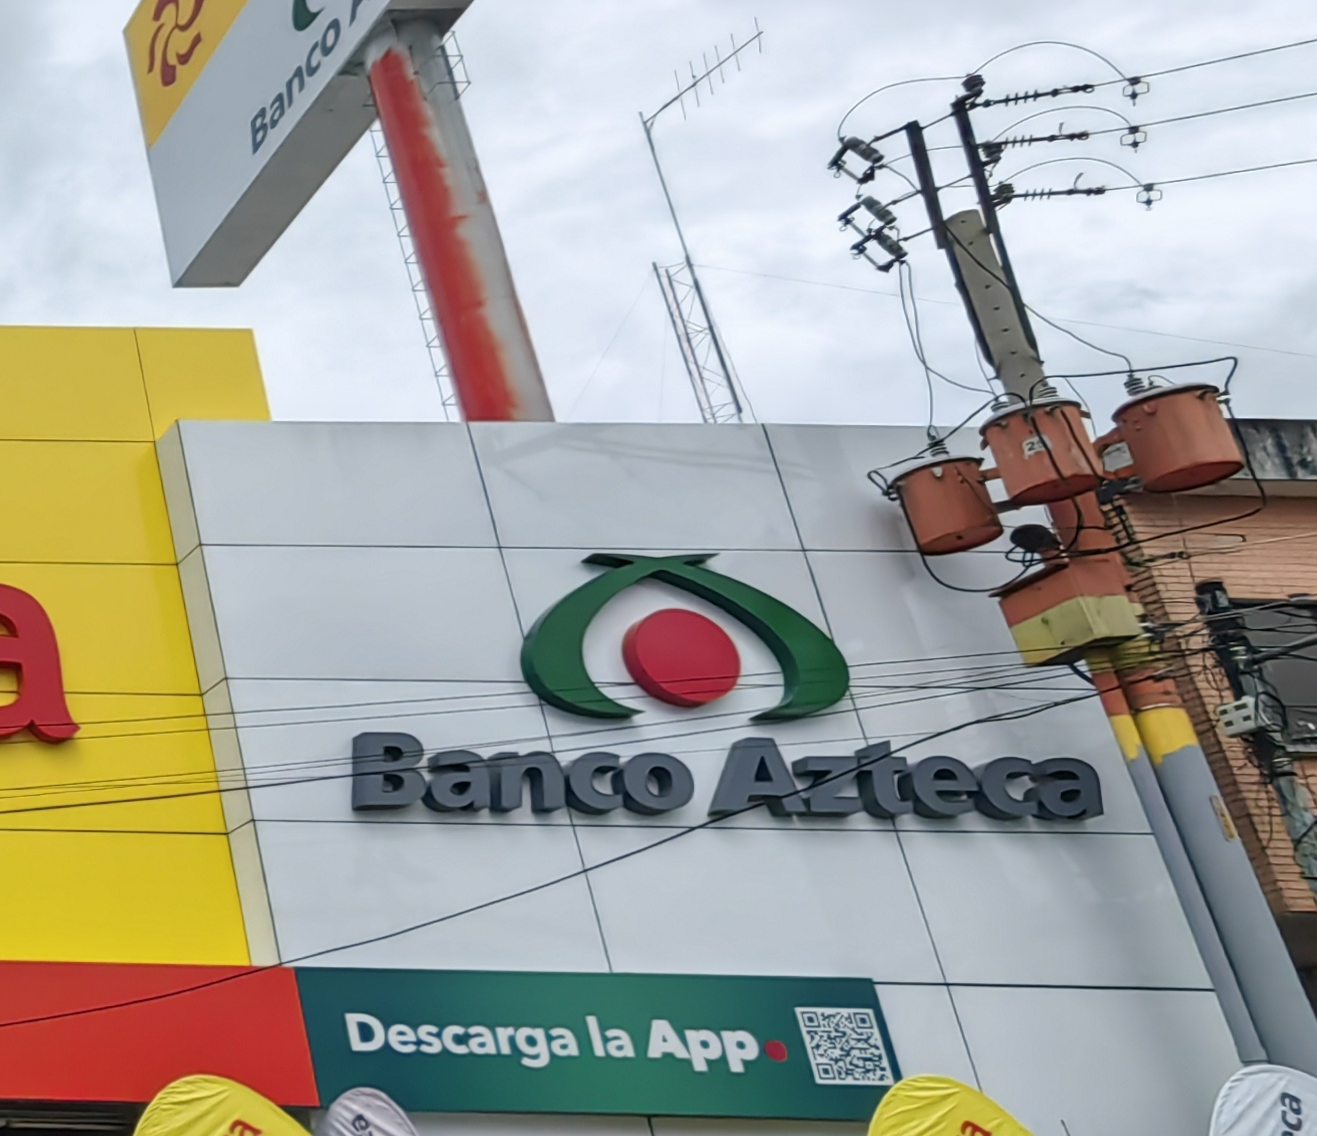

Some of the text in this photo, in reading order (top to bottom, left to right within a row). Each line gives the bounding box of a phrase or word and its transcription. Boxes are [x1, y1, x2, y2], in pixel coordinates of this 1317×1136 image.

[250, 18, 341, 156] Banco
[351, 731, 1105, 822] Banco Azteca
[344, 1013, 579, 1068] Descarga
[586, 1016, 635, 1060] la
